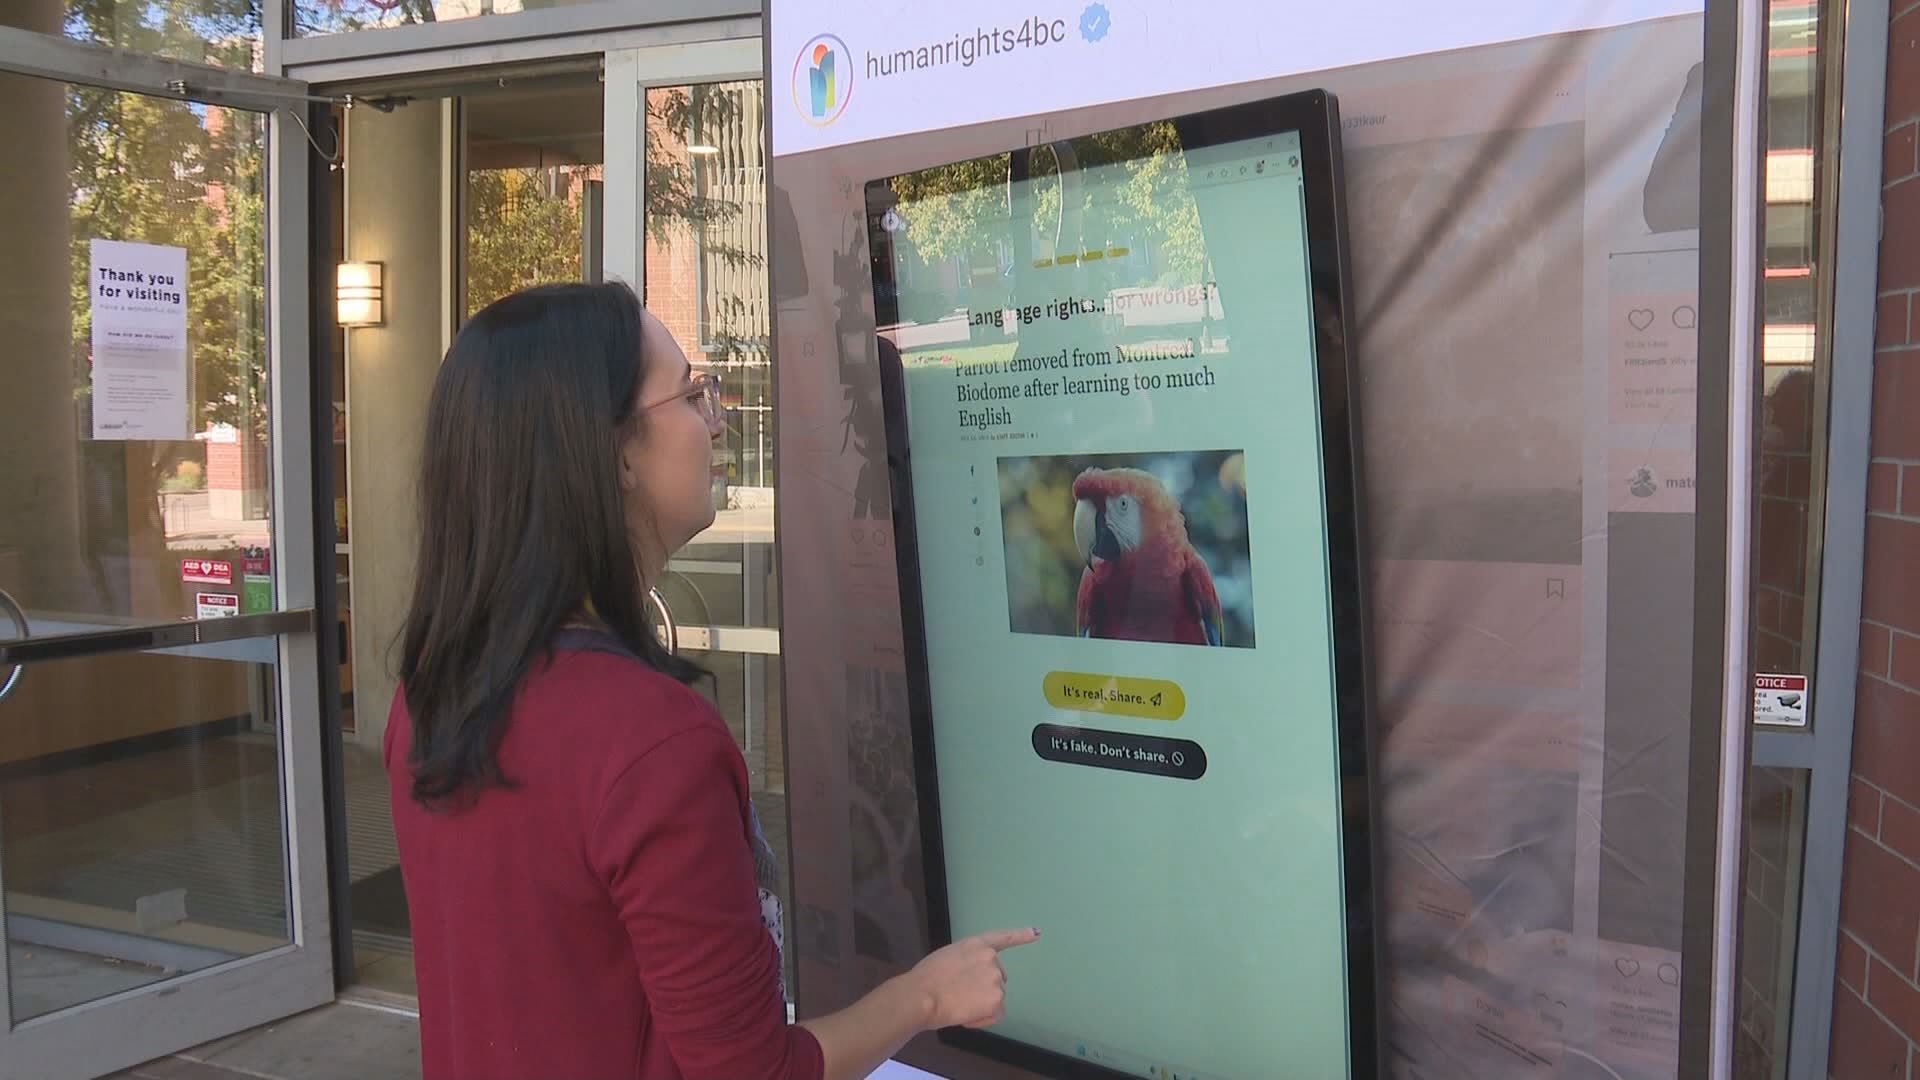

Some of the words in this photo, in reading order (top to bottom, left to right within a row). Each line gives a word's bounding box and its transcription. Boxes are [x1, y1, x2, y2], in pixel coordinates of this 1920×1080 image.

[866, 16, 1066, 80] humanrights4bc
[99, 267, 144, 283] Thank
[148, 274, 174, 286] you
[99, 284, 121, 298] for
[126, 287, 180, 305] visiting
[955, 358, 1000, 377] Parrot
[1003, 348, 1069, 373] removed
[1072, 347, 1112, 368] from
[1115, 338, 1195, 364] Montreal
[957, 381, 1021, 402] Biodome
[1024, 378, 1060, 398] after
[1062, 373, 1130, 396] learning
[1134, 373, 1161, 390] too
[1166, 365, 1216, 389] much
[959, 406, 1012, 431] English
[184, 562, 200, 570] AED
[1756, 677, 1787, 689] OTICE
[1063, 685, 1081, 699] It's
[1083, 688, 1107, 701] real.
[1110, 689, 1146, 705] Share.
[1051, 736, 1068, 751] It's
[1071, 739, 1097, 756] fake.
[1100, 743, 1131, 759] Don't
[1133, 748, 1169, 765] share.
